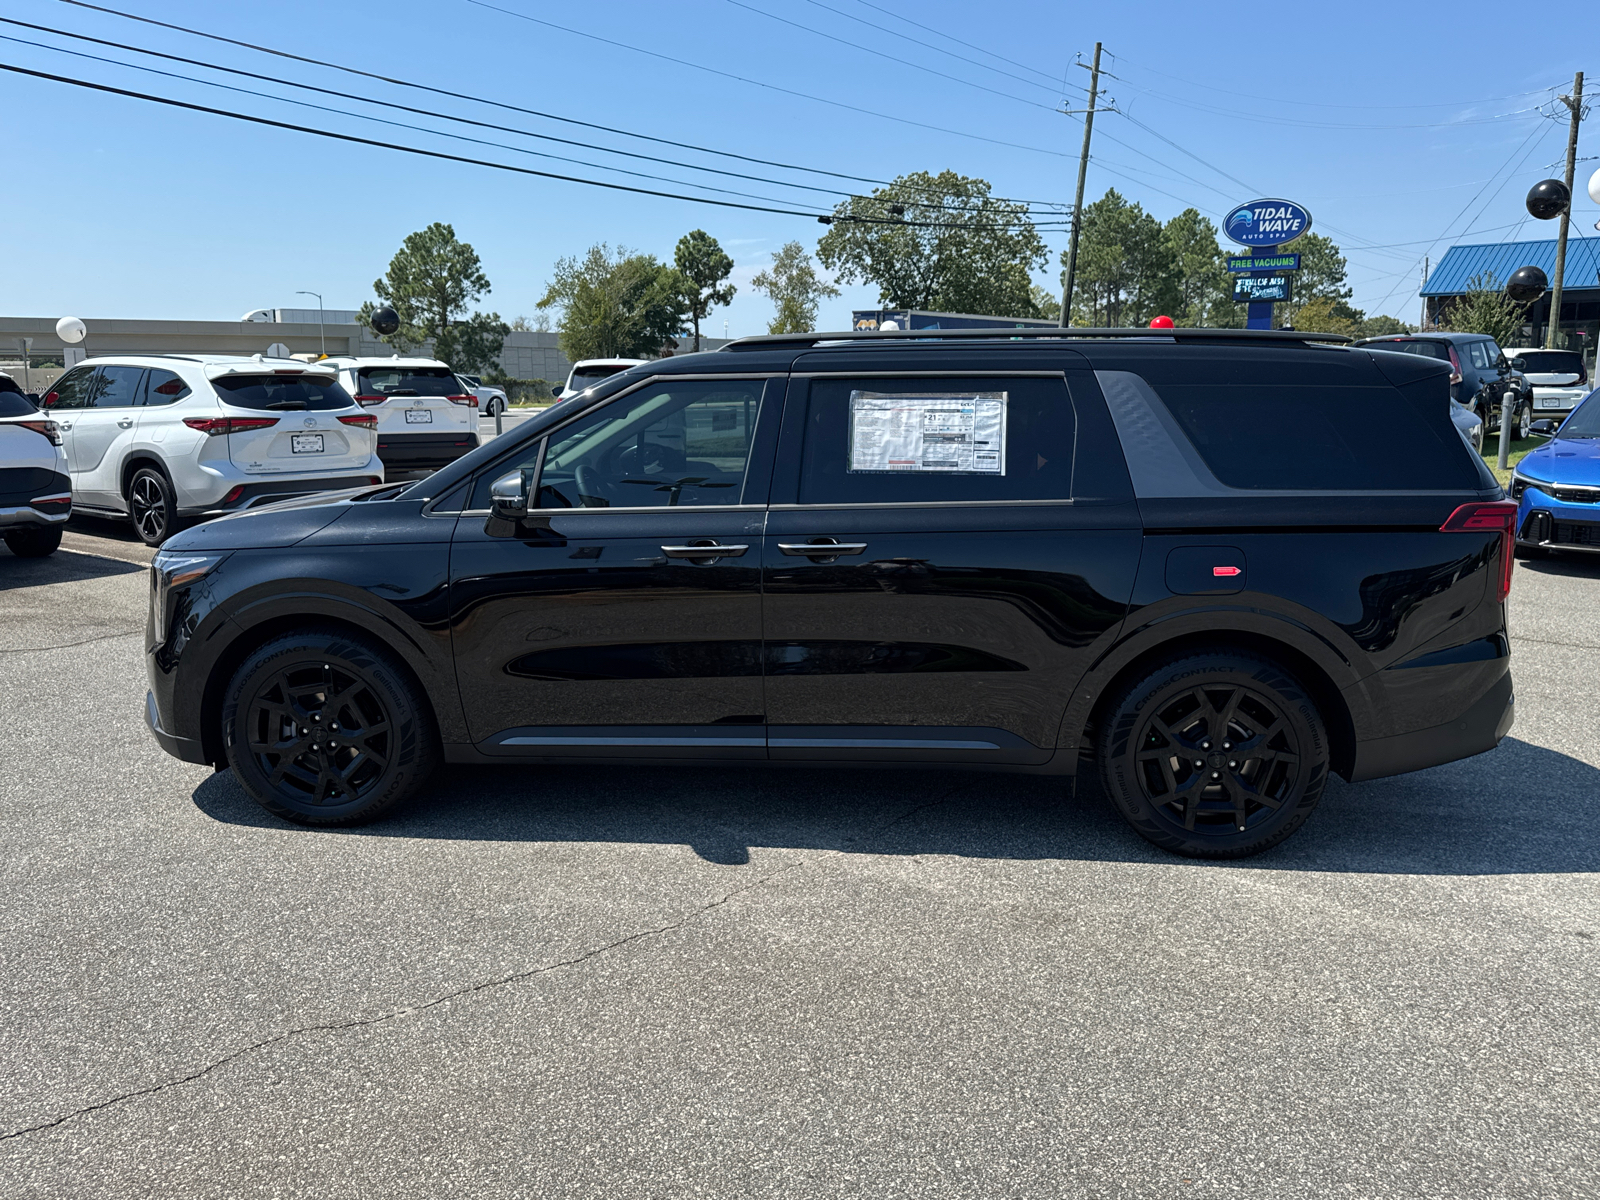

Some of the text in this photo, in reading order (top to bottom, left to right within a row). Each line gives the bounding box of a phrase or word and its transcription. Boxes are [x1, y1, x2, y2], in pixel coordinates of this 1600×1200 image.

[1253, 207, 1293, 220] TIDAL
[1259, 219, 1301, 232] WAVE
[1230, 257, 1295, 268] FREE VACUUMS
